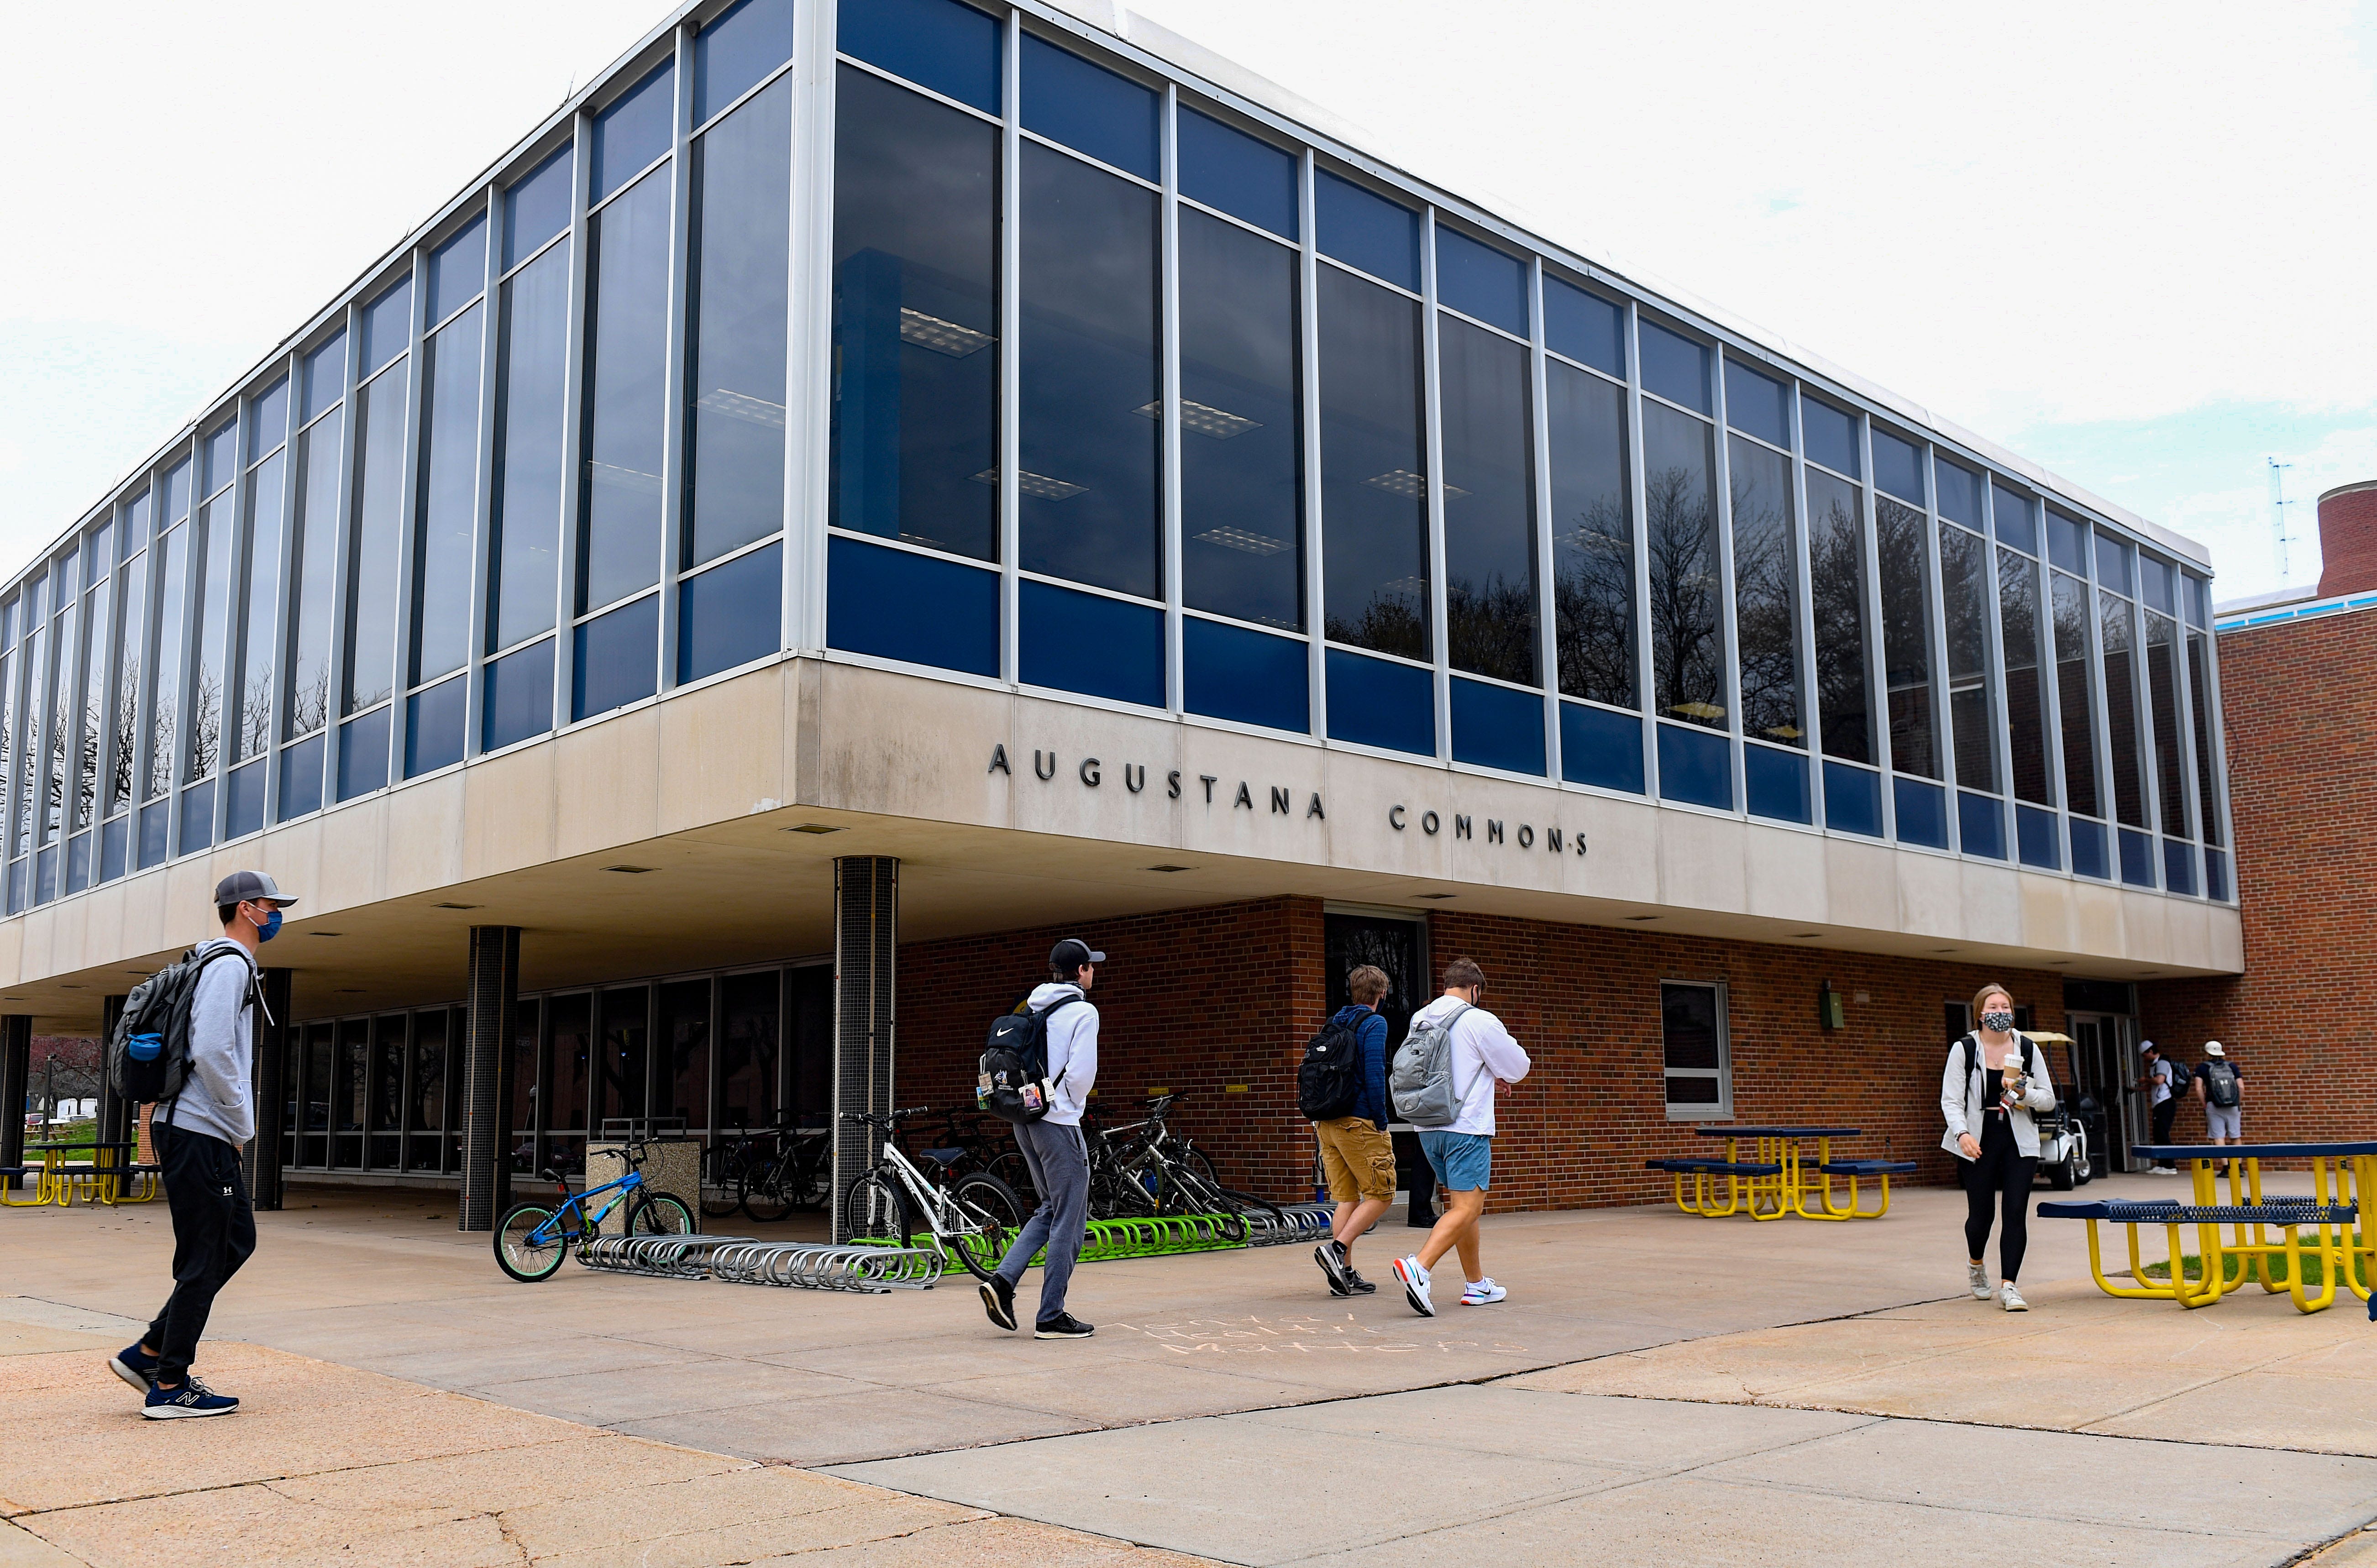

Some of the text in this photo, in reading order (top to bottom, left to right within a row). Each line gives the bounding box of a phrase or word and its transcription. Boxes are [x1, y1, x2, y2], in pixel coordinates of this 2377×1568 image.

[987, 743, 1587, 857] AUGUSTANA COMMONS
[1160, 1341, 1528, 1354] Matters
